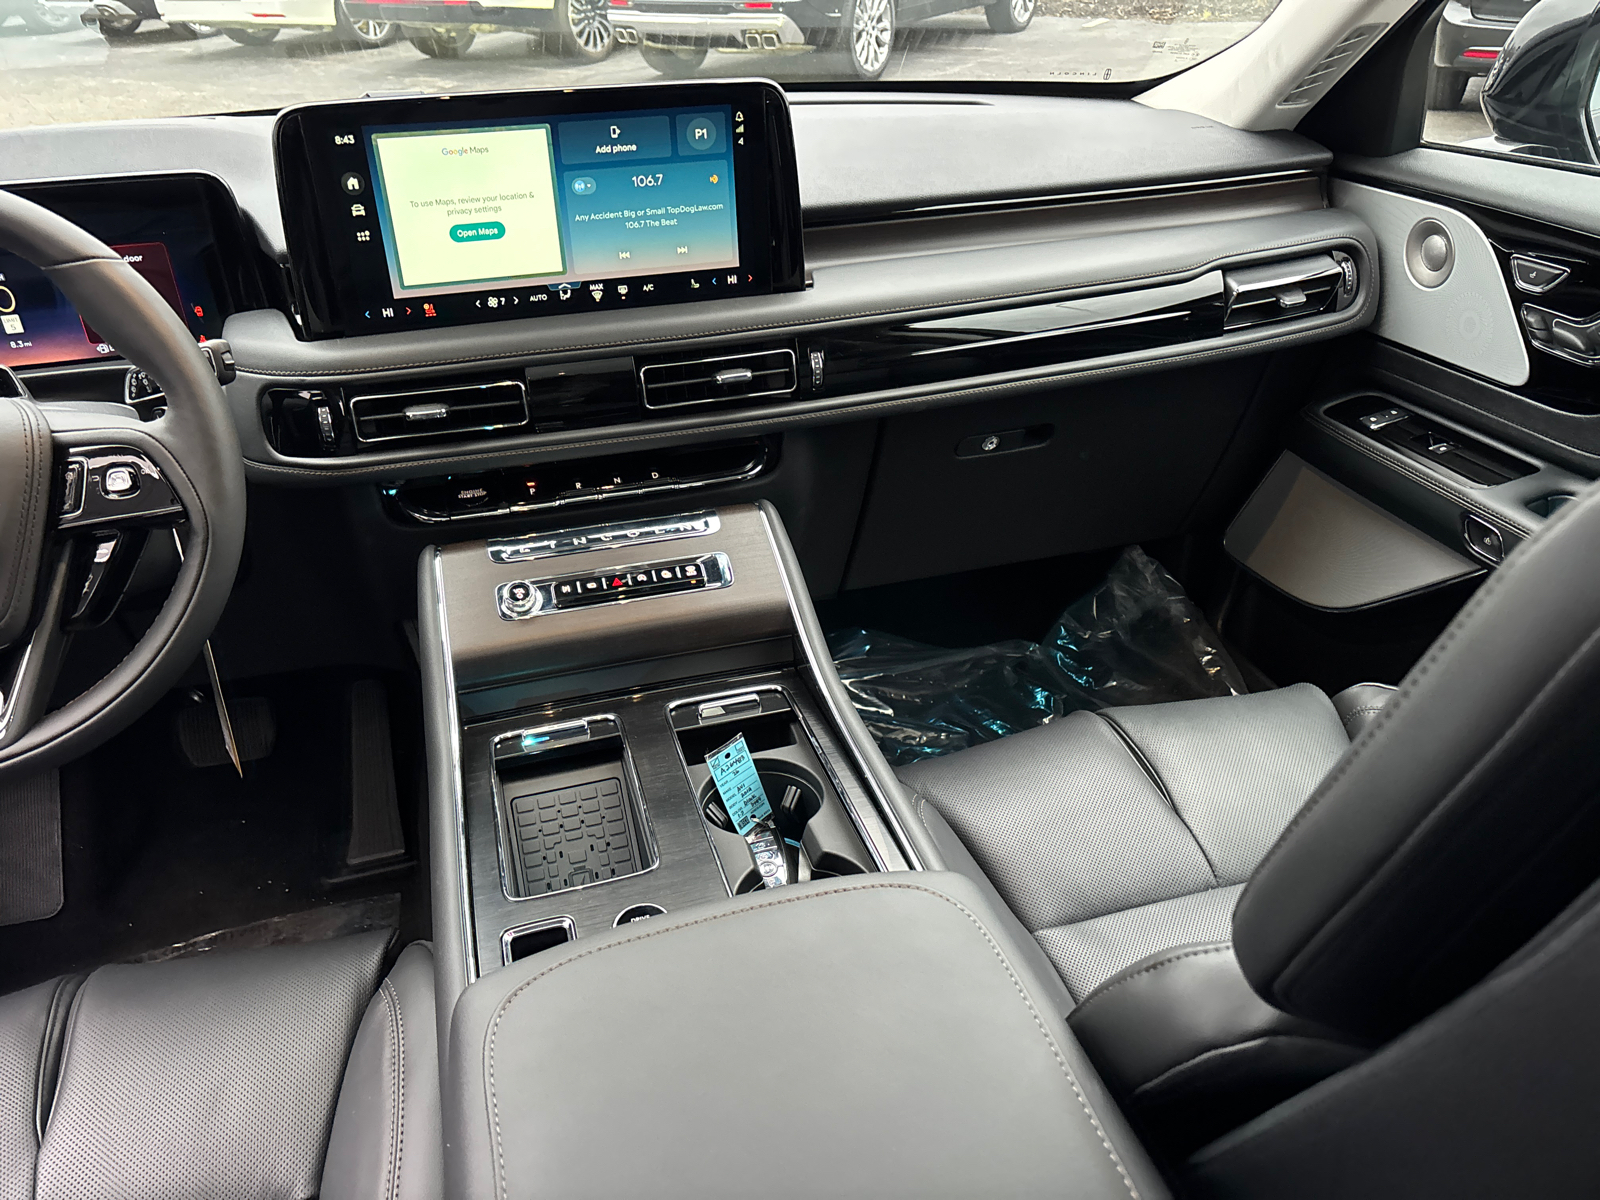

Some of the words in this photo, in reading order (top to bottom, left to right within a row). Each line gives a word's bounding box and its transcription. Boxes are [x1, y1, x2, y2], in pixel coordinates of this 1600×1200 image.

[694, 128, 708, 140] P1
[334, 134, 355, 145] 8:43
[441, 147, 469, 156] Google
[469, 146, 489, 154] Maps
[595, 145, 611, 154] Add
[612, 144, 637, 154] phone
[631, 173, 664, 188] 106.7
[410, 200, 419, 208] To
[420, 200, 433, 208] use
[435, 198, 456, 206] Maps,
[457, 196, 480, 204] review
[482, 195, 498, 203] your
[499, 192, 527, 201] location
[529, 191, 535, 199] &
[447, 207, 472, 217] privacy
[474, 205, 502, 214] settings
[575, 214, 589, 222] Any
[590, 211, 623, 221] Accident
[624, 209, 636, 219] Big
[646, 207, 666, 216] Small
[667, 203, 724, 215] TopDogLaw.com
[625, 221, 645, 229] 106.7
[646, 219, 660, 227] The
[661, 218, 678, 227] Beat
[456, 228, 477, 238] Open
[478, 227, 499, 237] Maps
[123, 254, 143, 263] door
[727, 274, 738, 285] HI
[589, 283, 604, 291] MAX
[643, 283, 655, 292] A/C
[499, 297, 506, 306] 7
[529, 293, 548, 302] AUTO
[382, 307, 394, 318] HI
[9, 340, 24, 349] 8.3
[613, 476, 621, 485] N
[651, 471, 659, 480] D
[575, 482, 582, 490] R
[529, 488, 536, 496] P
